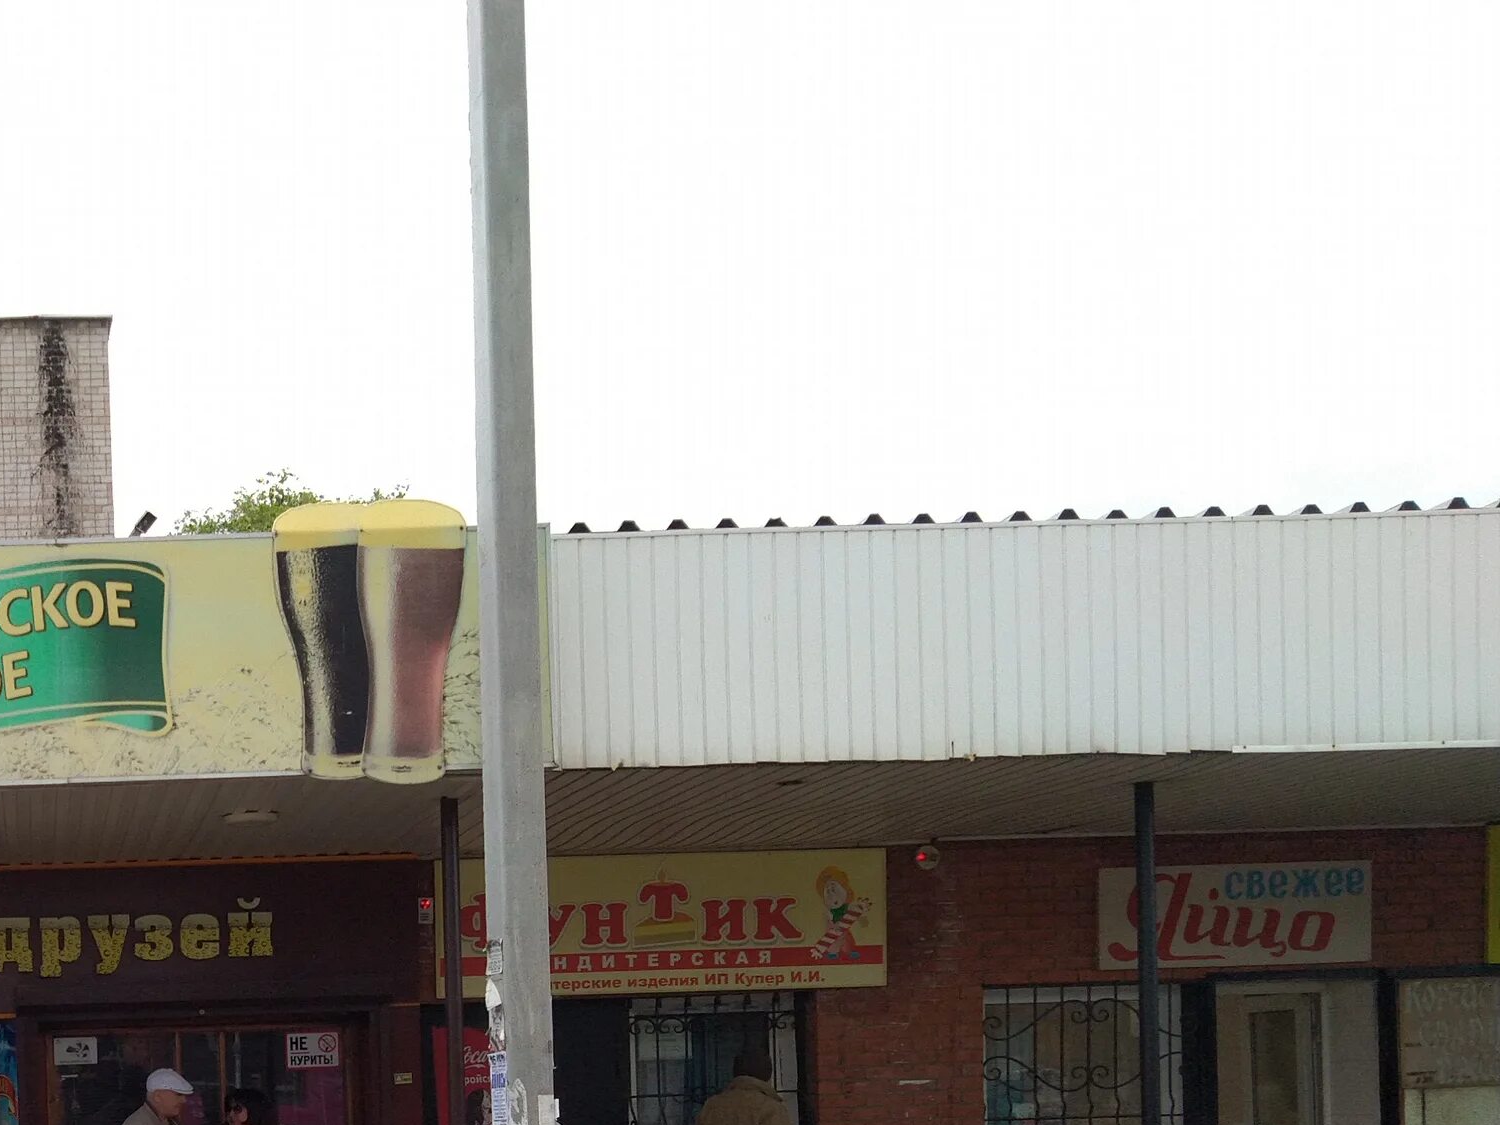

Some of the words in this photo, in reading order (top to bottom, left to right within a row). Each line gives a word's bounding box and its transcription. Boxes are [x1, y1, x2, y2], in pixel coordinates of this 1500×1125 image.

[1223, 867, 1366, 900] свежее
[553, 949, 773, 973] НДИТЕРСКАЯ
[550, 978, 622, 992] терские
[626, 975, 699, 990] изделия
[704, 973, 729, 985] ИП
[734, 972, 785, 987] Купер
[289, 1036, 309, 1051] НЕ
[289, 1054, 334, 1066] КУРИТЬ!
